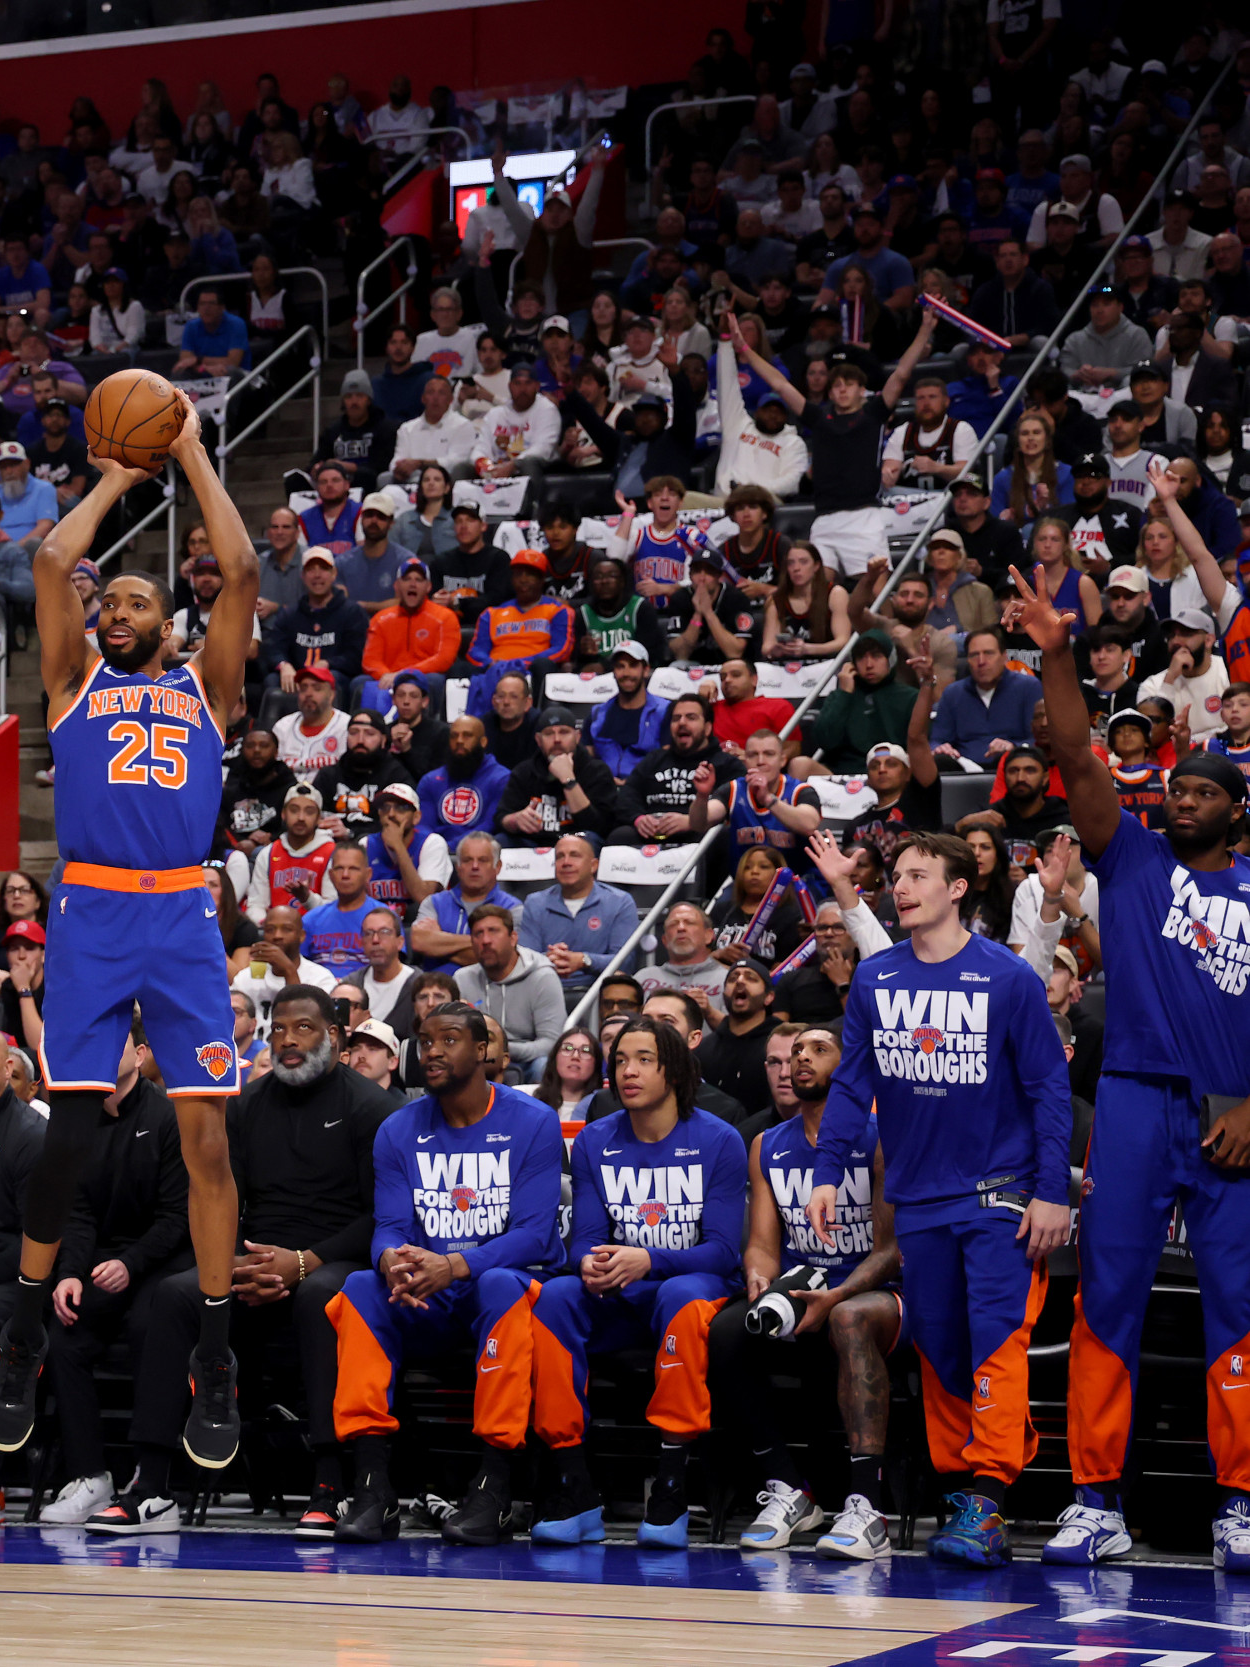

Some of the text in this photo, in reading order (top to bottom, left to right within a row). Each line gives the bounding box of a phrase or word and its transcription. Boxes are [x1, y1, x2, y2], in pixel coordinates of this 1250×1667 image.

[1111, 480, 1147, 496] TROIT
[495, 618, 550, 636] NEW YORK
[87, 685, 202, 730] NEW YORK
[108, 720, 189, 790] 25
[655, 768, 697, 782] DETRO
[1135, 792, 1165, 806] YORK
[369, 879, 409, 898] ETRO
[310, 932, 364, 949] PISTON
[874, 988, 989, 1033] WIN
[873, 1029, 988, 1052] FOR THE
[199, 1046, 233, 1062] KNICKS
[874, 1048, 988, 1085] BOROUGHS
[415, 1149, 511, 1190] WIN
[600, 1164, 702, 1204] WIN
[769, 1167, 872, 1206] WN
[413, 1186, 511, 1208] FOR THE
[667, 1203, 703, 1222] THE
[834, 1205, 872, 1223] THE
